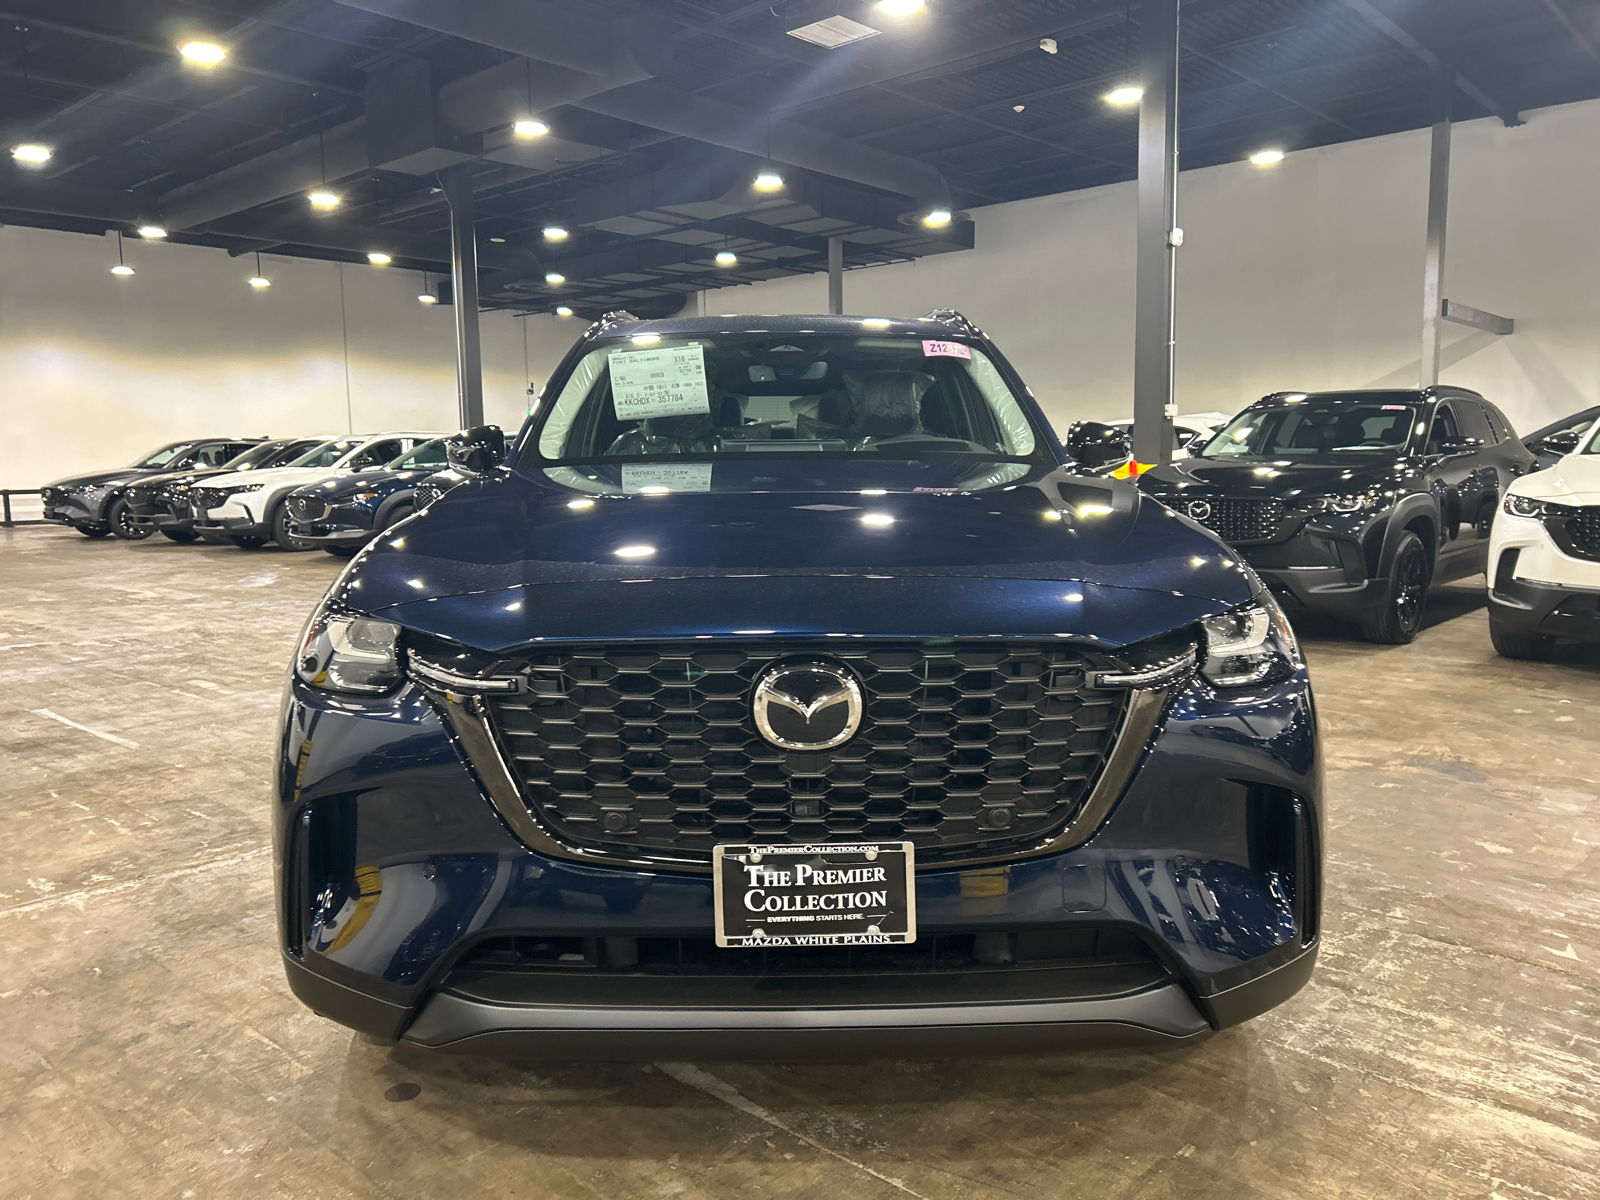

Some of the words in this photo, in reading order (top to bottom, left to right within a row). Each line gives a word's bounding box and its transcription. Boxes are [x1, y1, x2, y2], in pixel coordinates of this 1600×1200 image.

[629, 356, 660, 364] BALTIMORE
[674, 355, 686, 363] X16
[624, 396, 651, 406] KKCHDX
[657, 393, 683, 404] 357784
[743, 864, 791, 887] THE
[794, 864, 887, 886] PREMIER
[744, 889, 887, 912] COLLECTION
[767, 915, 815, 923] EVERYTHING
[815, 914, 843, 922] STARTS
[742, 936, 791, 946] MAZDA
[795, 935, 839, 945] WHITE
[843, 934, 891, 944] PLAINS
